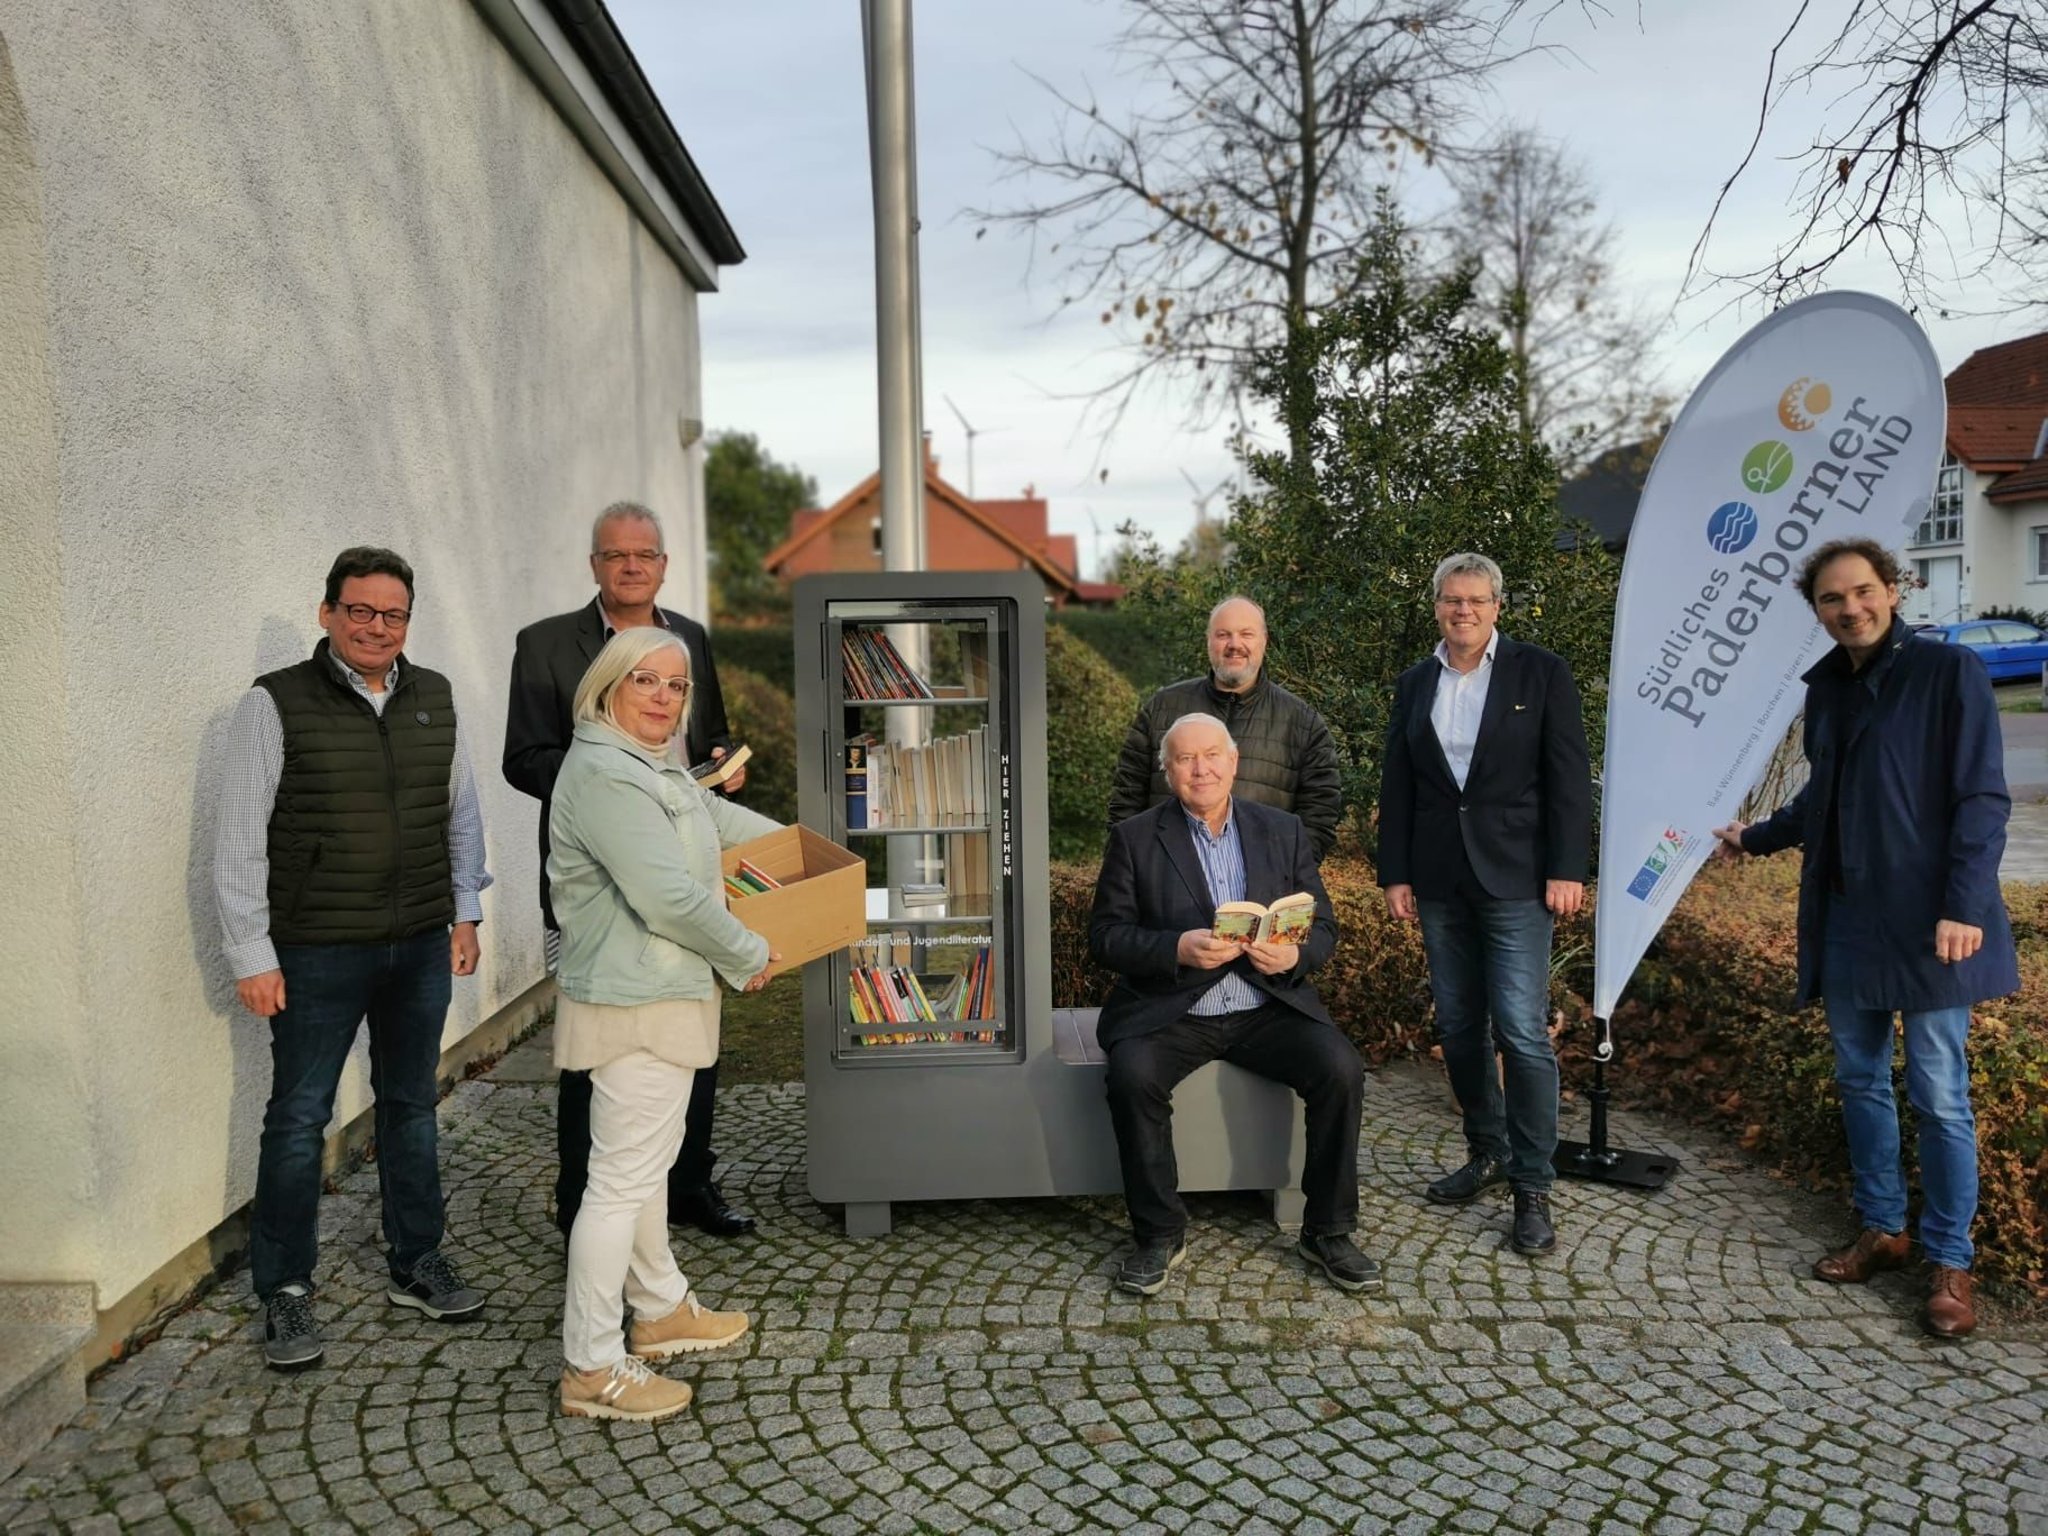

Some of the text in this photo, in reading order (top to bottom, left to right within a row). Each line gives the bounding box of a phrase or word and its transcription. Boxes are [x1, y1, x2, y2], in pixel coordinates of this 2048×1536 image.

[1836, 415, 1913, 514] LAND
[1660, 396, 1880, 728] Paderborner
[1637, 567, 1729, 705] Südliches
[1707, 790, 1722, 808] Bad
[1757, 687, 1784, 726] Borchen
[1001, 754, 1012, 876] HIER ZIEHEN
[889, 935, 911, 946] und
[912, 934, 993, 948] Jugendliteratur
